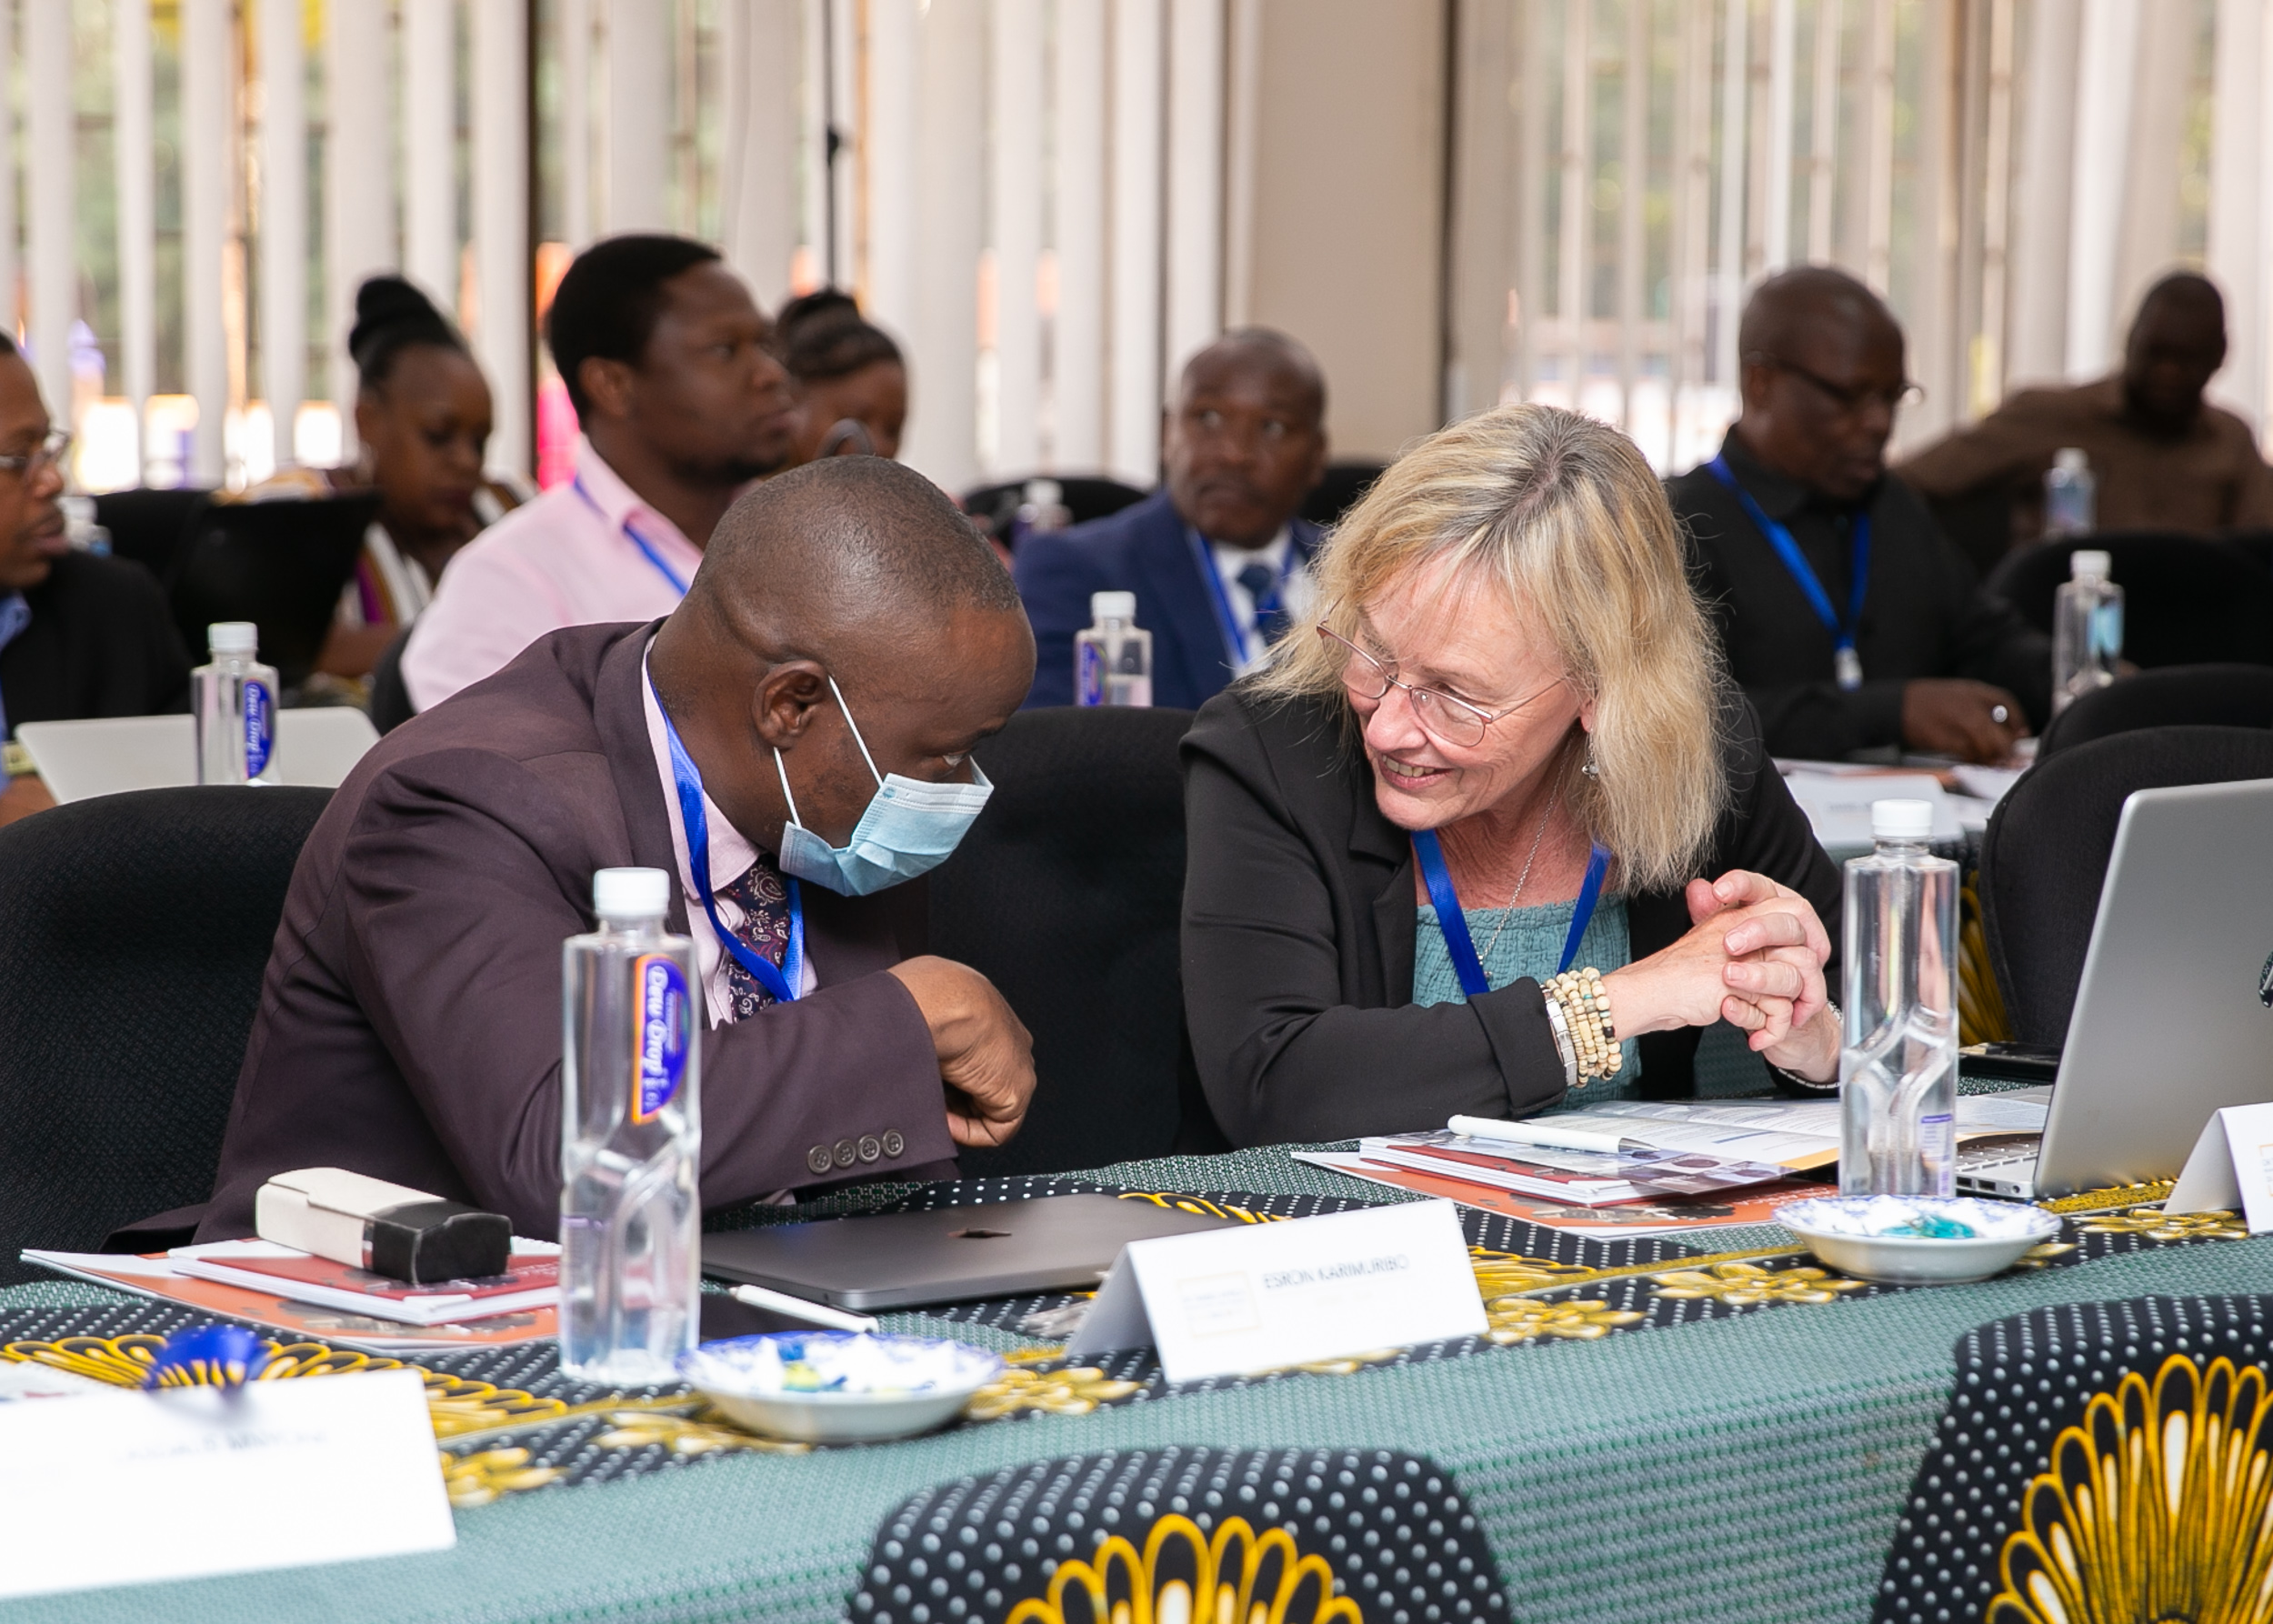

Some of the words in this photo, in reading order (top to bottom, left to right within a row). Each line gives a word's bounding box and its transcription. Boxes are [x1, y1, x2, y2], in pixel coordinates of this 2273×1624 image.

[647, 966, 668, 1019] Dew
[642, 1019, 668, 1077] Drop
[1263, 1268, 1315, 1289] ESRON
